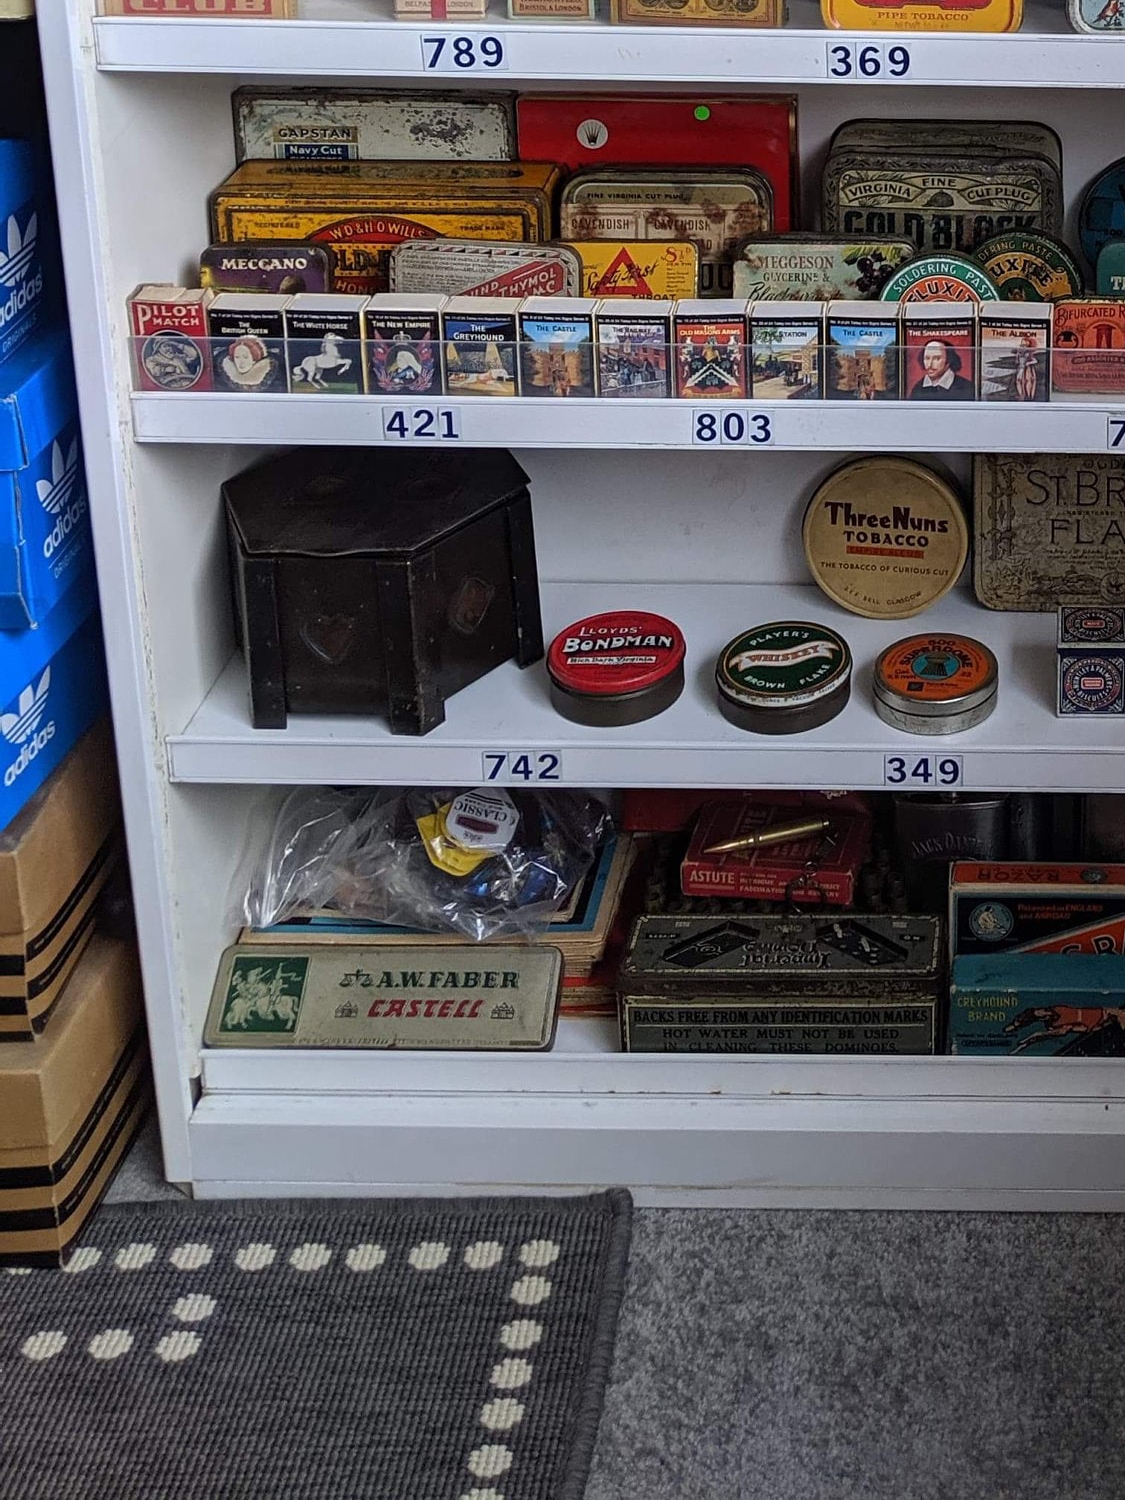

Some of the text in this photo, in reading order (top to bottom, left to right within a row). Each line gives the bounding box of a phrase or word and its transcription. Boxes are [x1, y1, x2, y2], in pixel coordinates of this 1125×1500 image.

[425, 36, 504, 69] 789
[829, 45, 911, 77] 369
[289, 145, 342, 157] Navy Cut
[849, 181, 912, 199] VIRGINIA
[922, 178, 957, 188] FINE
[966, 186, 1031, 200] CUT PLUG
[571, 217, 630, 230] CAVENDISH
[654, 218, 711, 231] CAVENDISH
[221, 257, 307, 271] MECCANO
[137, 304, 199, 336] PILOT
[152, 317, 200, 326] MATCH
[1054, 306, 1117, 327] BIFURCATED
[454, 332, 505, 341] GREYHOUND
[386, 409, 459, 438] 421
[696, 413, 772, 443] 803
[44, 500, 86, 558] adidas
[843, 531, 929, 548] TOBACCO
[820, 561, 949, 577] THE TOBACCO OF CURIOUS CUT
[563, 636, 673, 653] BONDMAN
[749, 630, 810, 647] PLAYER'S
[743, 675, 786, 689] BROWN
[799, 663, 831, 685] FLAKE
[3, 720, 56, 787] adidas
[485, 754, 560, 781] 742
[886, 757, 960, 785] 349
[689, 870, 735, 885] ASTUTE
[367, 1000, 485, 1019] CASTELL
[957, 997, 1018, 1008] GREYHOUND
[634, 1010, 928, 1024] BACKS FREE FROM ANY IDENTIFICATION MARKS
[968, 1012, 1006, 1022] BRAND
[662, 1029, 692, 1039] HOT
[700, 1029, 748, 1039] WATER
[756, 1029, 793, 1039] MUST
[802, 1029, 831, 1039] NOT
[863, 1029, 899, 1039] USED
